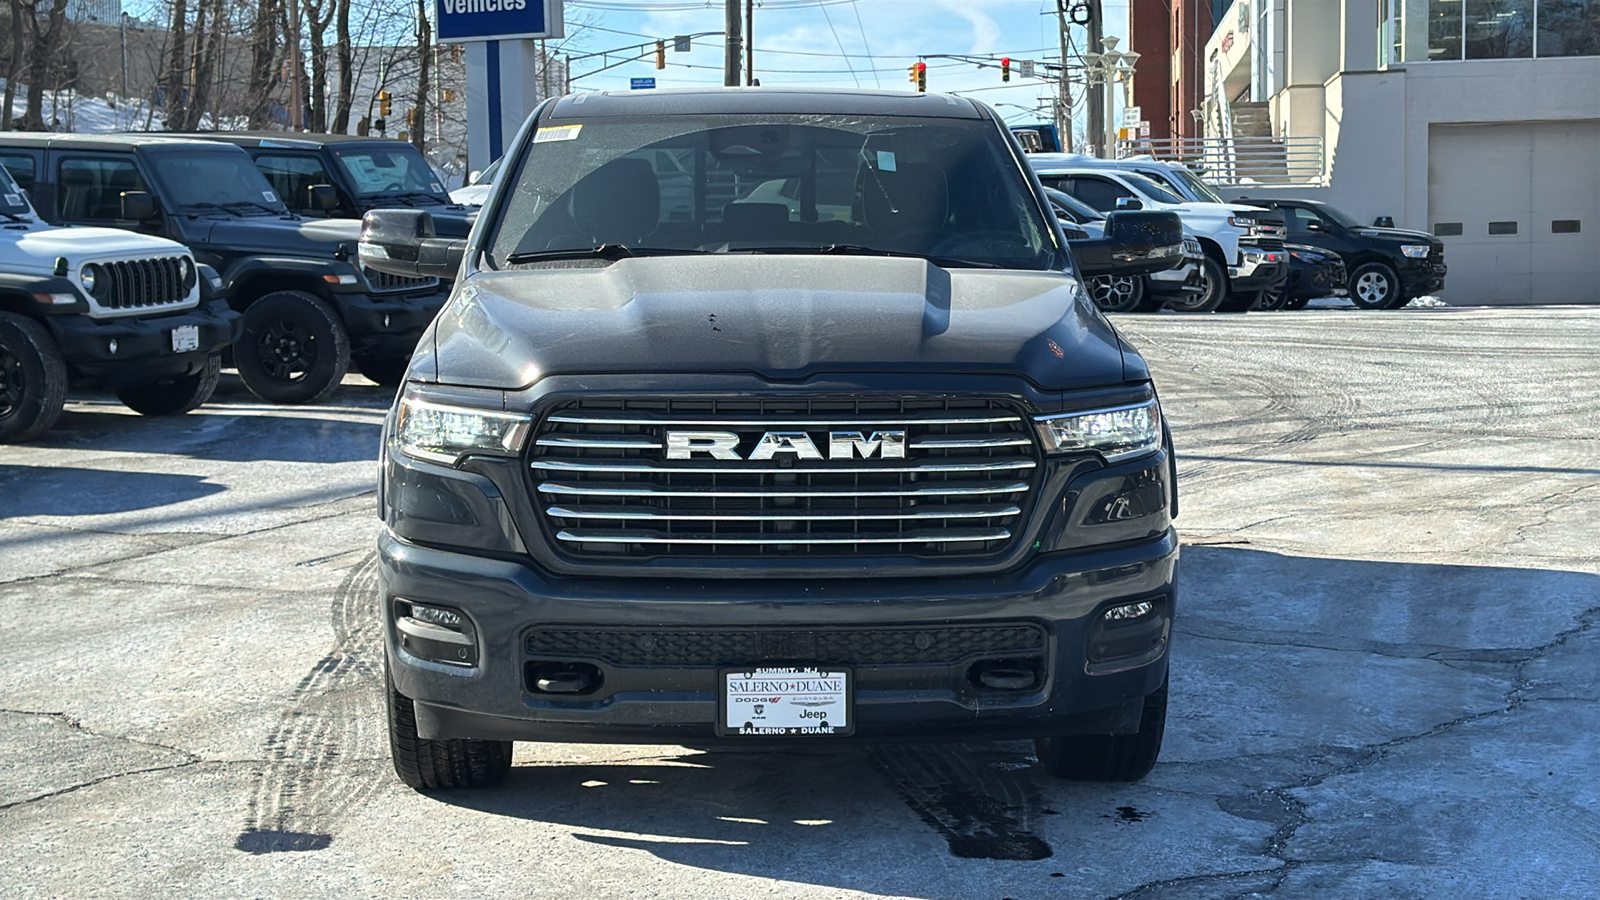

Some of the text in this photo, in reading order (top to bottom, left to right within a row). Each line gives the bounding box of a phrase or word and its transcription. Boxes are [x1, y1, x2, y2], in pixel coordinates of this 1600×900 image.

[666, 430, 905, 460] RAM
[729, 680, 842, 693] SALERNO DUANE
[799, 709, 827, 721] Jeep
[739, 727, 786, 735] SALERNO
